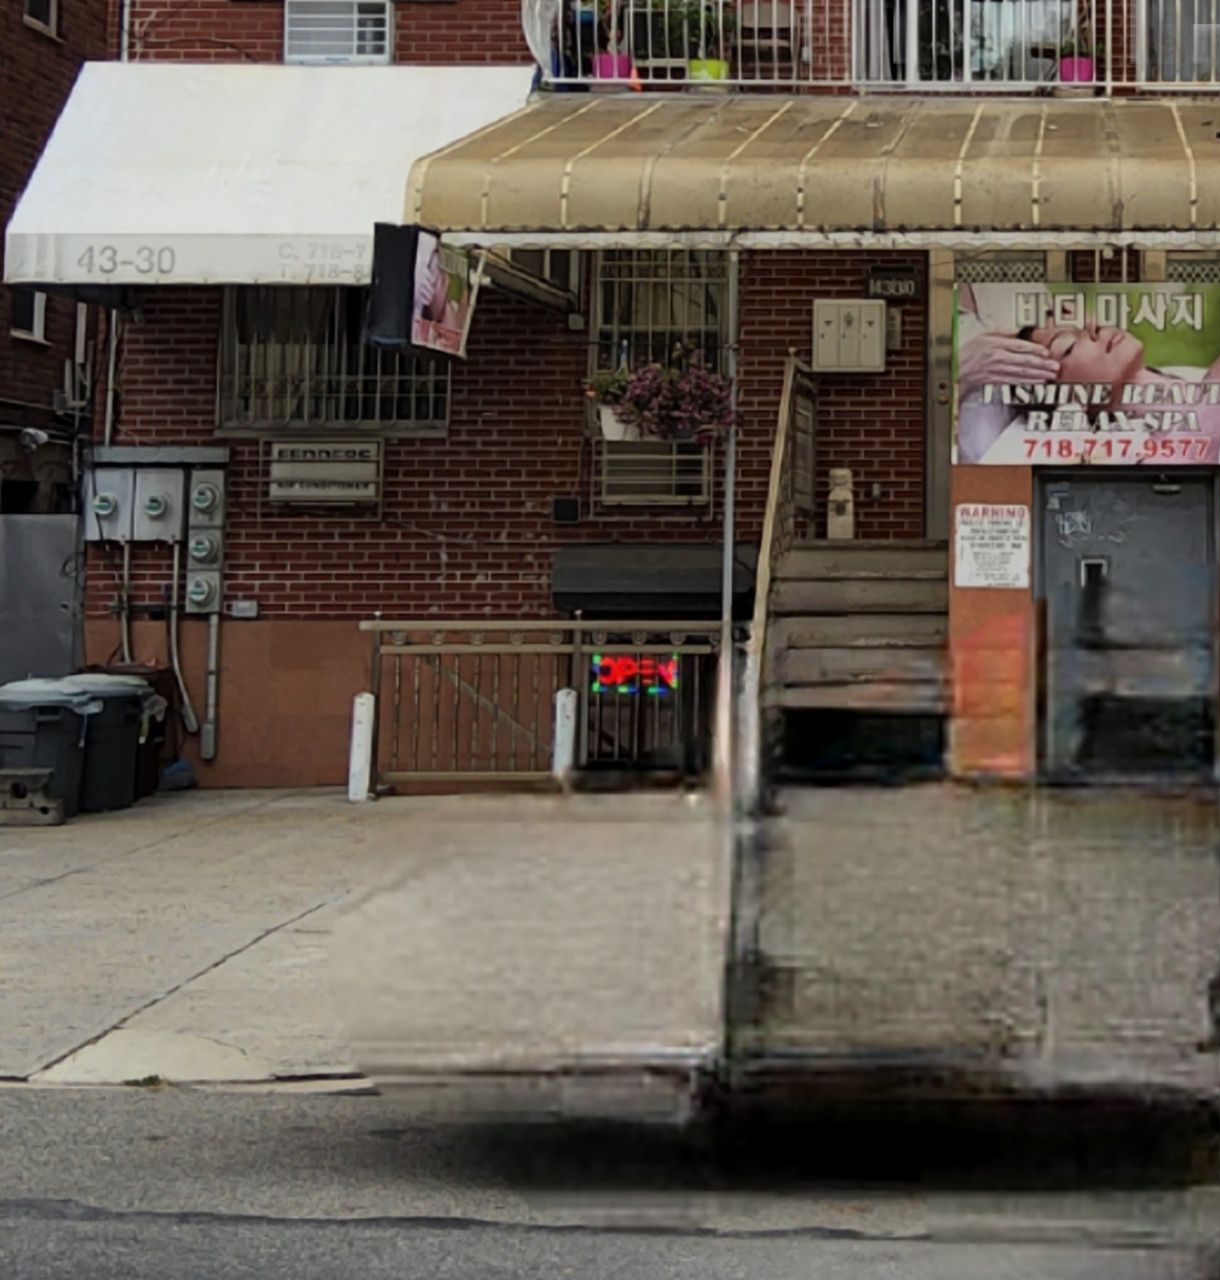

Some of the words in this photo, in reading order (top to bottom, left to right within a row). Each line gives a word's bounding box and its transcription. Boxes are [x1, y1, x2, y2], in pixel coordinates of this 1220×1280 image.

[78, 245, 174, 274] 43-30
[1014, 292, 1086, 330] 바디
[1096, 293, 1205, 331] 마사지
[981, 382, 1112, 405] JASMINE
[1024, 410, 1135, 432] RELAX
[1142, 410, 1201, 432] SPA
[1023, 438, 1211, 458] 718.717.9577
[599, 656, 676, 686] OPEN
